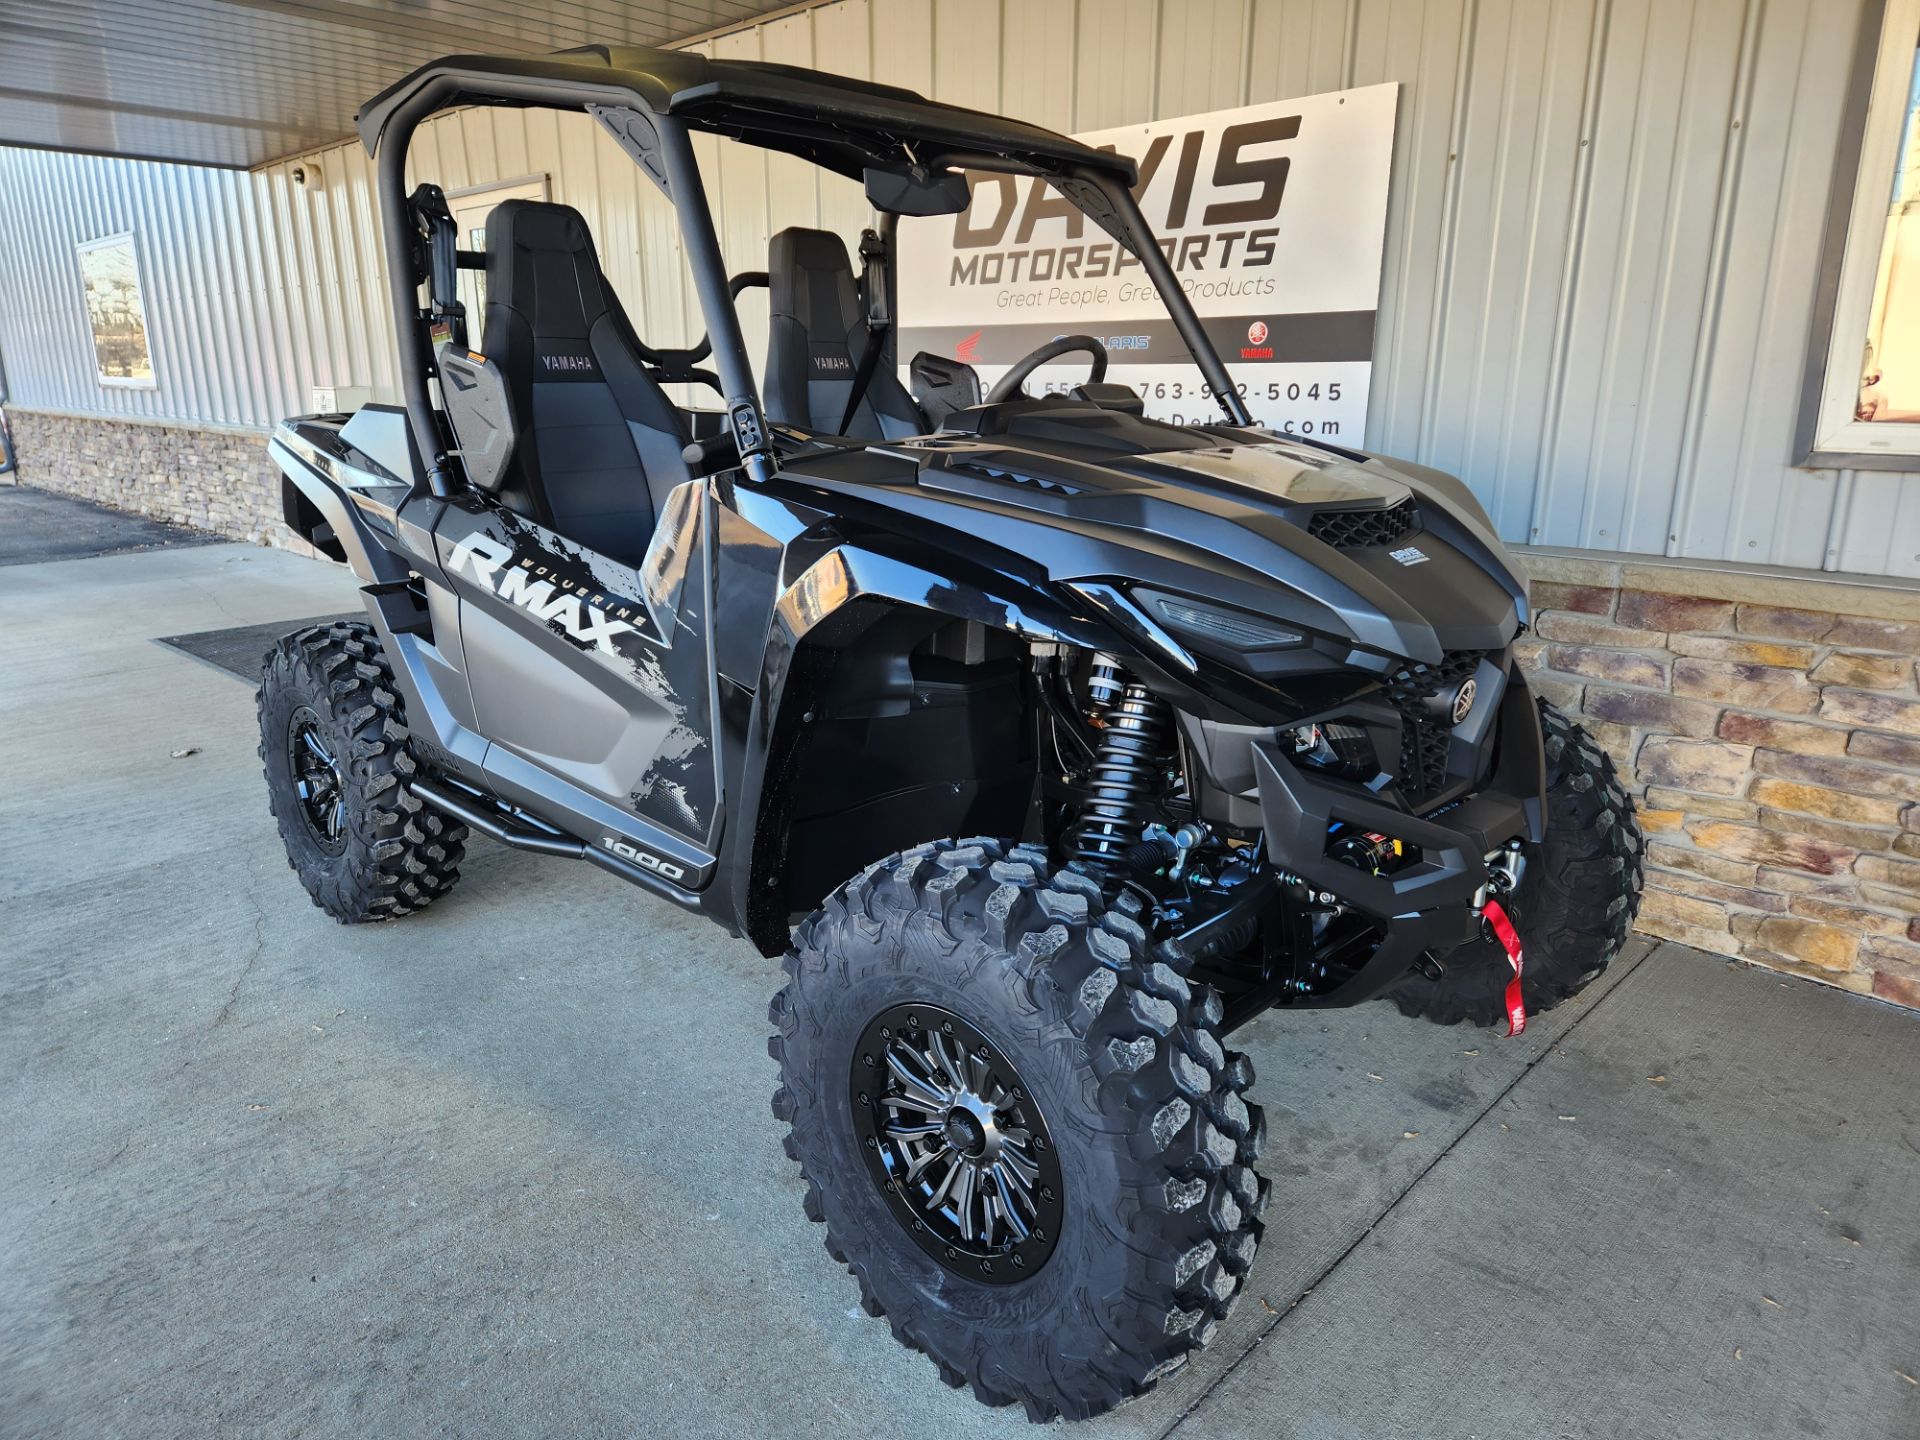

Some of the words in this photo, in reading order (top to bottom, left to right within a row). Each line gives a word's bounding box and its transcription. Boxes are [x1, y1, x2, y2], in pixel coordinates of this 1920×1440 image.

[997, 290, 1042, 308] Great
[1048, 285, 1110, 309] People,
[1118, 282, 1162, 302] Grea
[1183, 275, 1276, 299] Products
[1094, 335, 1149, 350] LARIS
[1240, 347, 1273, 359] YAMAHA
[542, 356, 592, 370] YAMAHA
[814, 357, 850, 370] YAMAHA
[1140, 382, 1342, 400] 763-92-5045
[448, 531, 638, 658] RMAX
[602, 837, 685, 880] 1000
